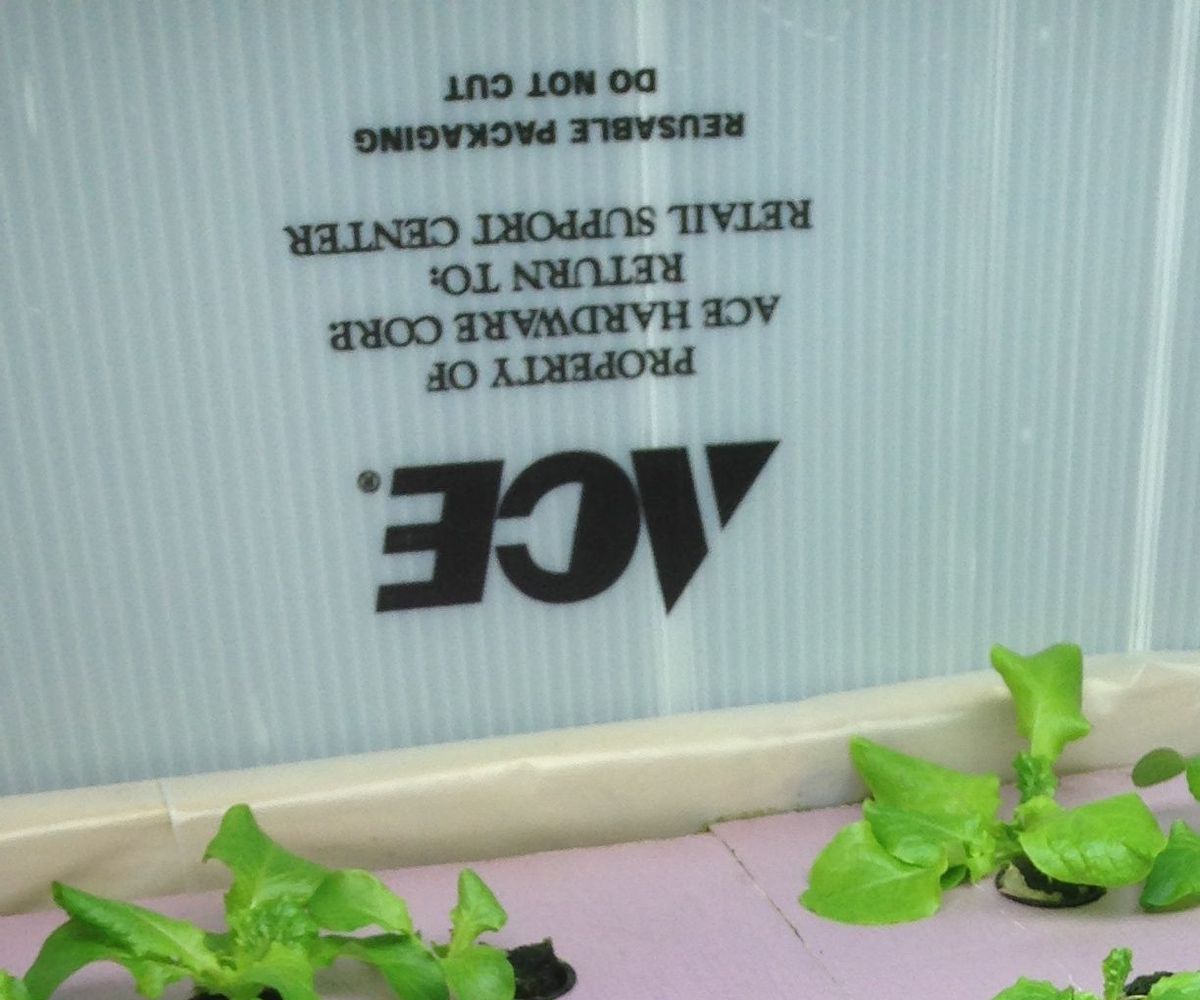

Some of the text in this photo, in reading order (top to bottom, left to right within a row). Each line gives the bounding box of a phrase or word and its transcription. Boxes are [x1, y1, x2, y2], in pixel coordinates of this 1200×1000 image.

[442, 67, 658, 103] DO NOT CUT
[351, 110, 747, 156] REUSABLE PACKAGING
[281, 196, 814, 259] RETAIL SUPPORT CENTER
[429, 251, 686, 297] RETURN TO:
[453, 298, 692, 344] HARDWARE
[700, 293, 782, 330] ACE
[424, 345, 698, 394] PROPERTY OF
